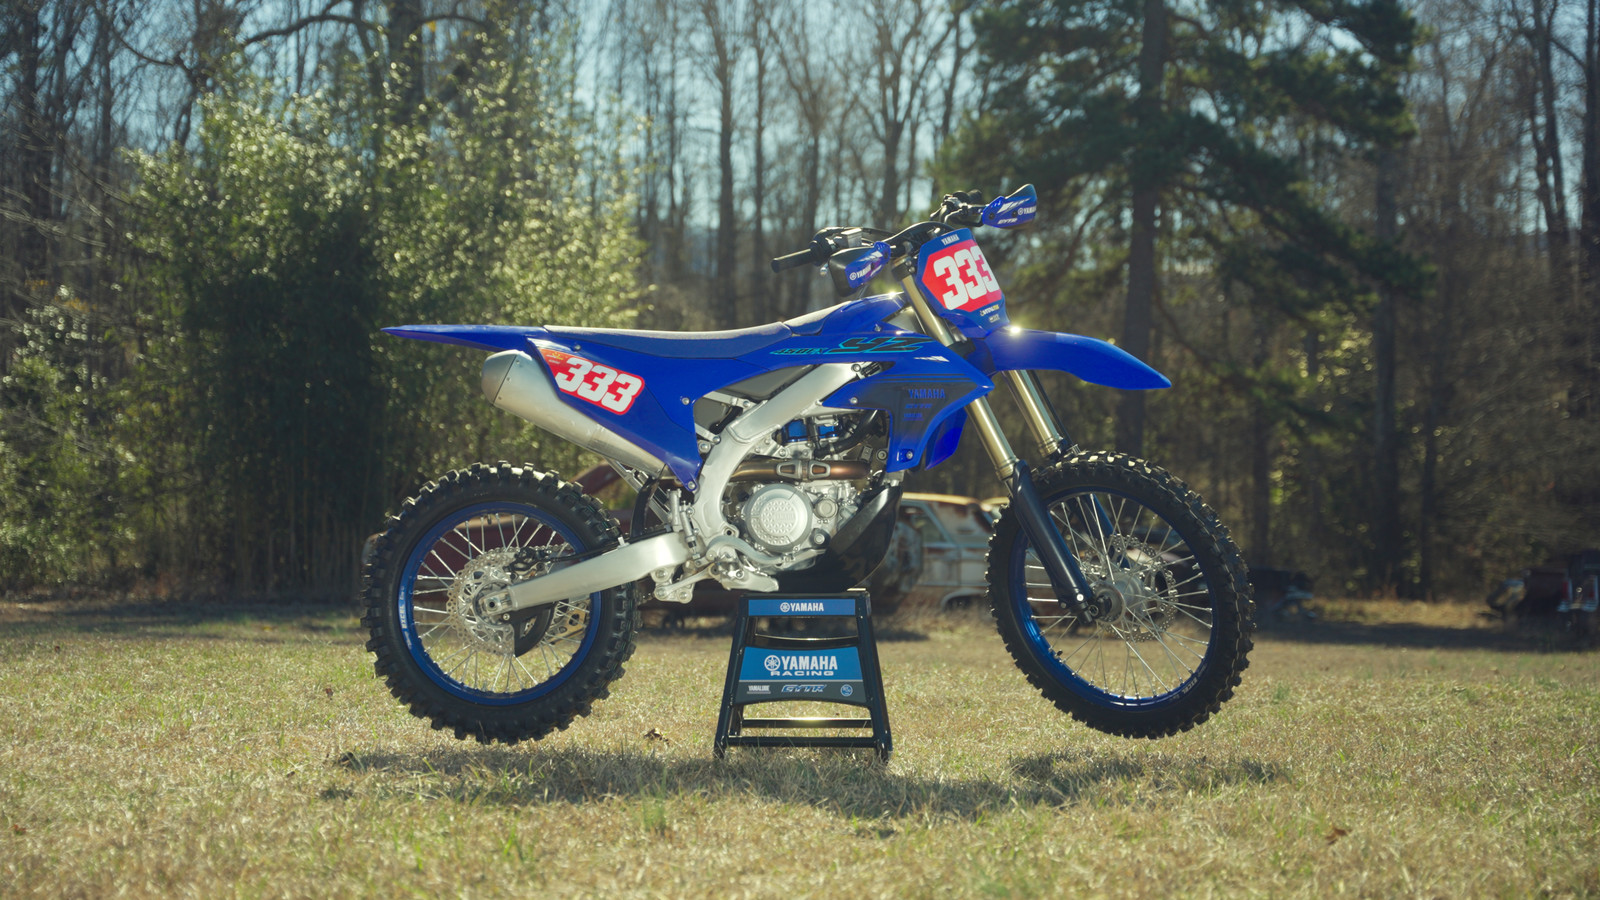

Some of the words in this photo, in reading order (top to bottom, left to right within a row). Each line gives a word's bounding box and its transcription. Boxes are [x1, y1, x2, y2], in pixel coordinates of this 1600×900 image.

[933, 245, 1000, 311] 333
[554, 357, 643, 412] 333
[908, 388, 946, 399] YAMAHA
[790, 602, 824, 612] YAMAHA
[781, 655, 838, 670] YAMAHA
